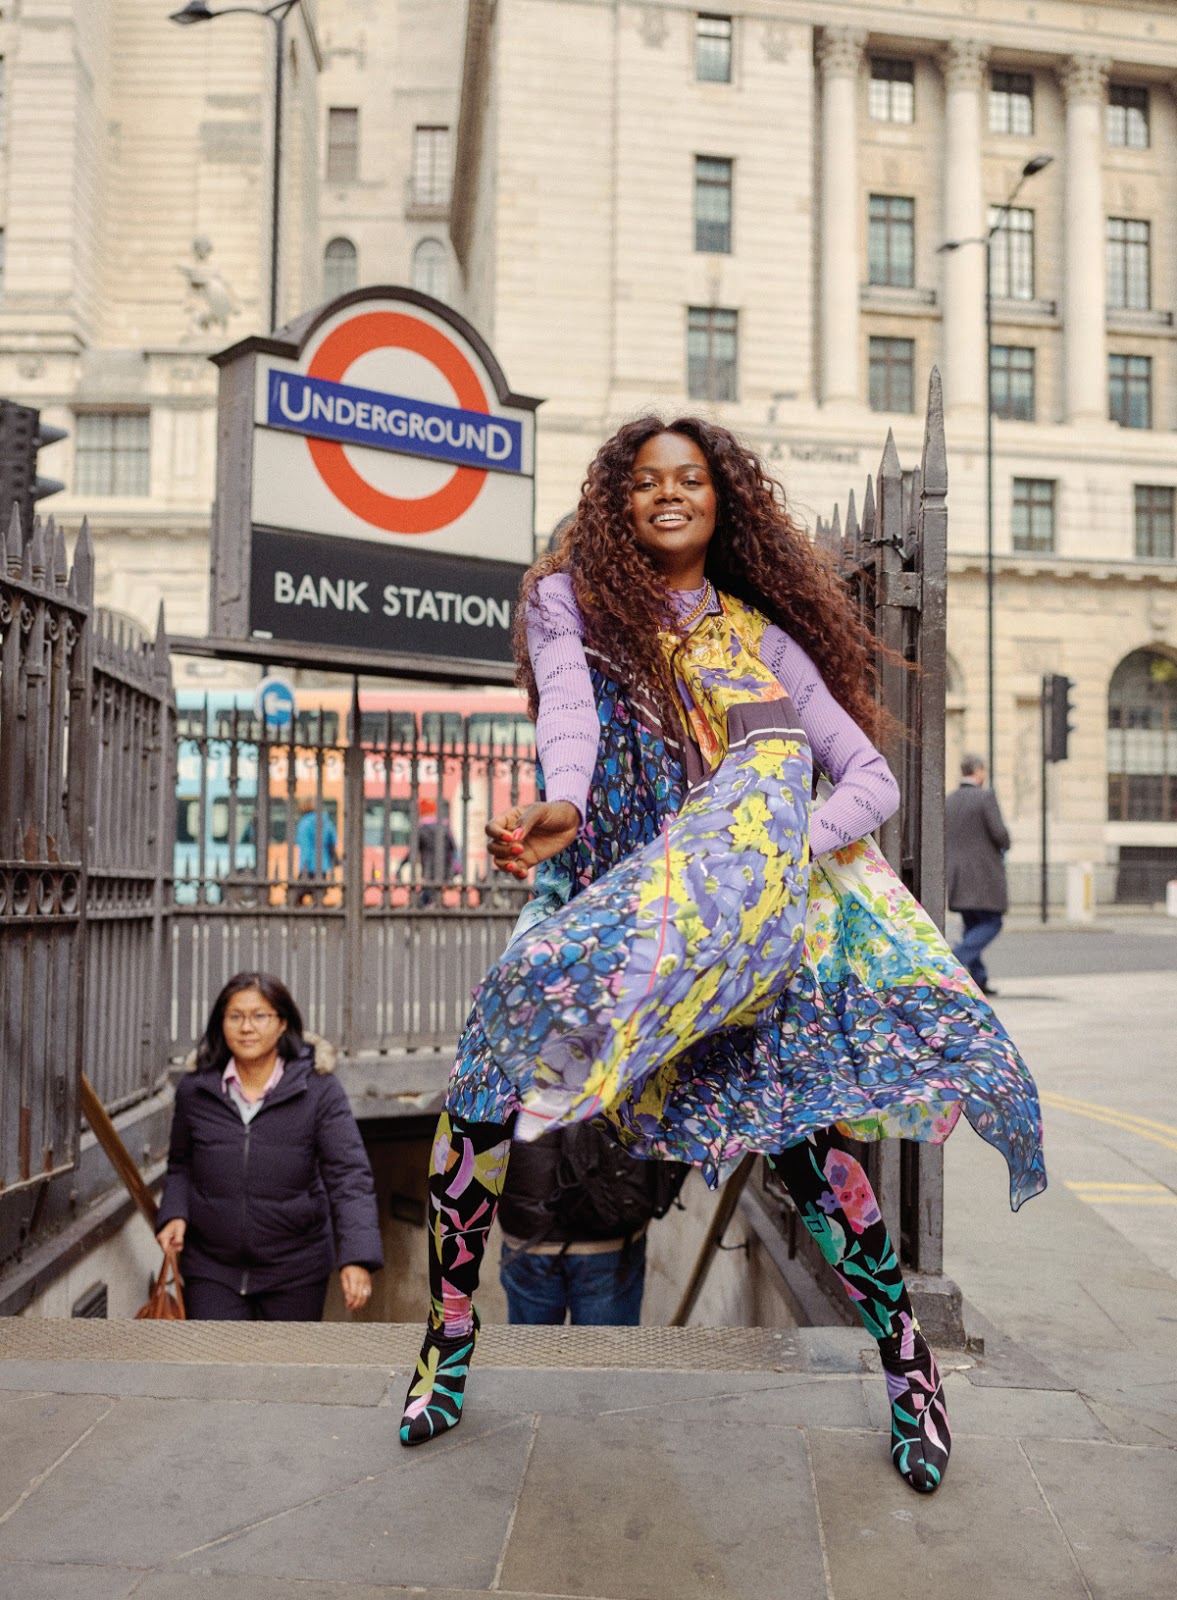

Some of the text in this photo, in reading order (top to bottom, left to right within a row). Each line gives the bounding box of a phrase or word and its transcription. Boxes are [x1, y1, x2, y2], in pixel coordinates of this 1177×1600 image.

[280, 381, 512, 460] UNDERGROUND
[274, 571, 509, 629] BANK STATION
